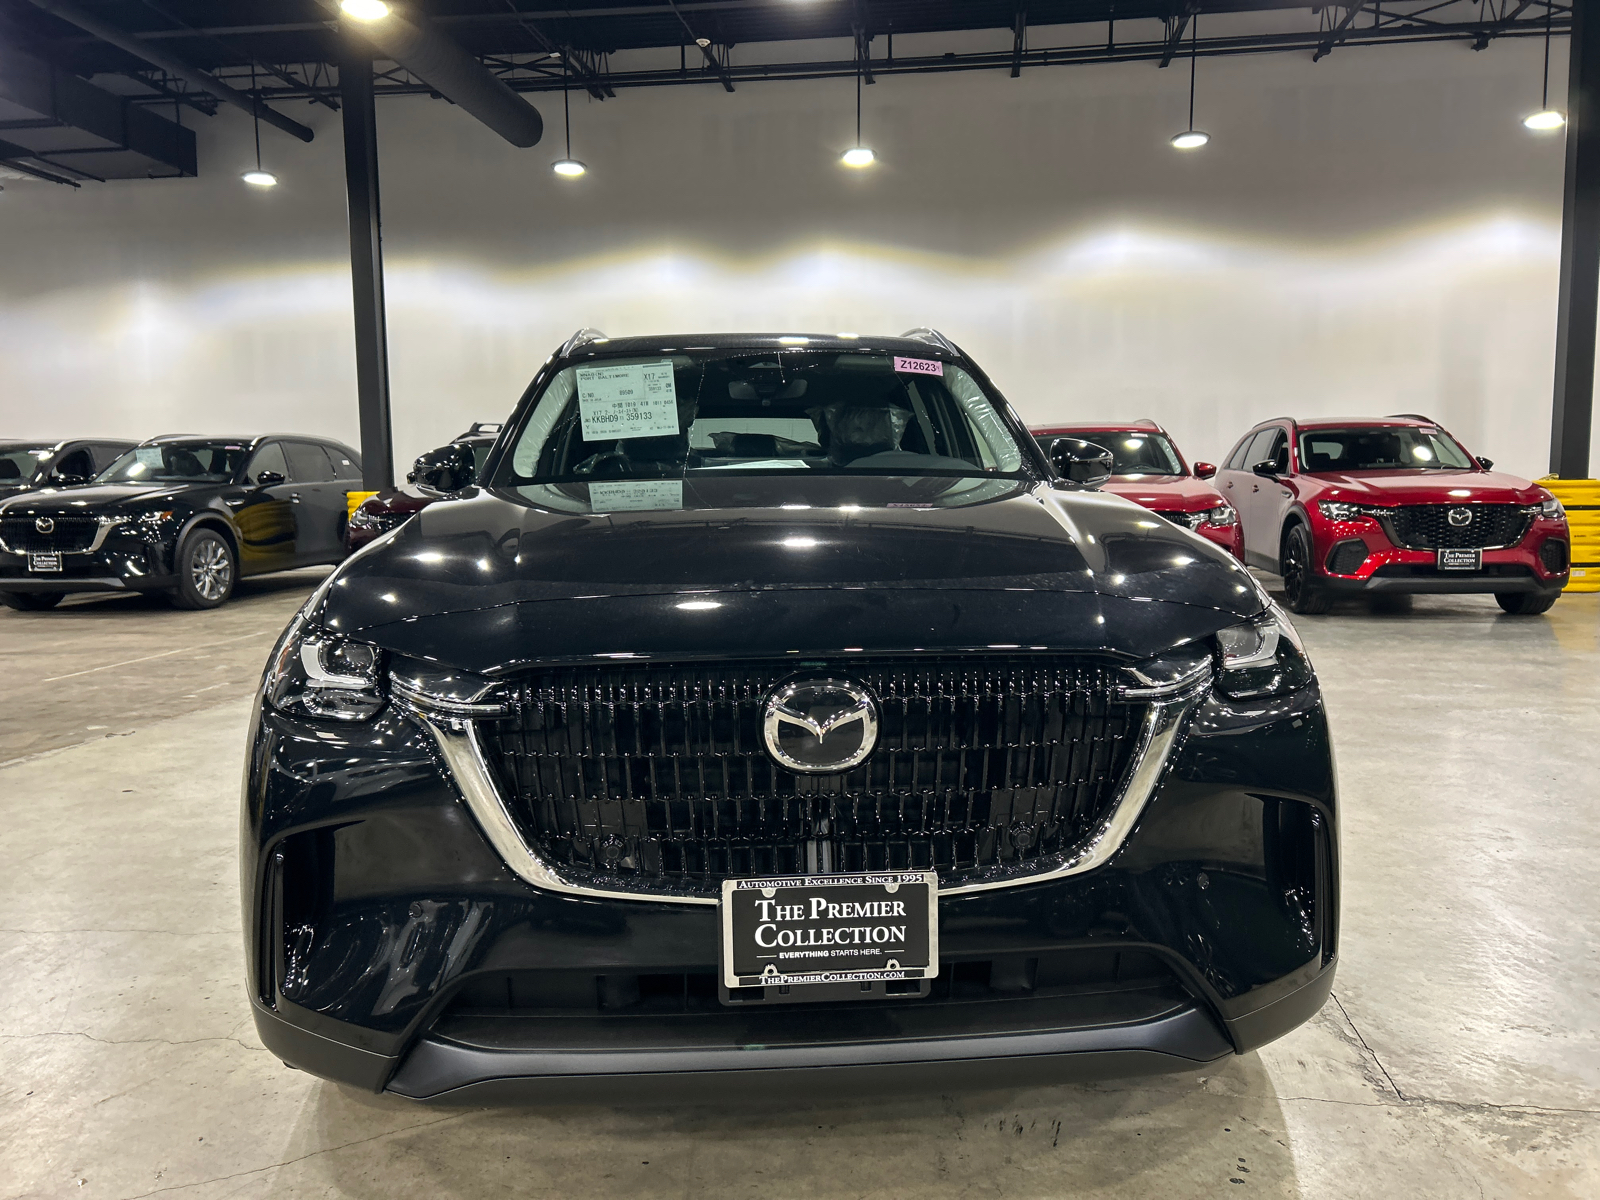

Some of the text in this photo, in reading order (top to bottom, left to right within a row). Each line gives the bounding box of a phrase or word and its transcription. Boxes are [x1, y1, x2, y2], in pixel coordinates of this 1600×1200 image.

[900, 359, 937, 372] Z12623
[643, 372, 655, 380] X17
[626, 411, 653, 421] 359133
[738, 874, 923, 889] AUTOMOTIVE EXCELLENCE SINCE 1995
[754, 897, 907, 922] THE PREMIER
[754, 923, 907, 948] COLLECTION
[779, 948, 883, 959] EVERYTHING STARTS HERE.
[759, 970, 906, 985] THEPREMIERCOLLECTION.COM
